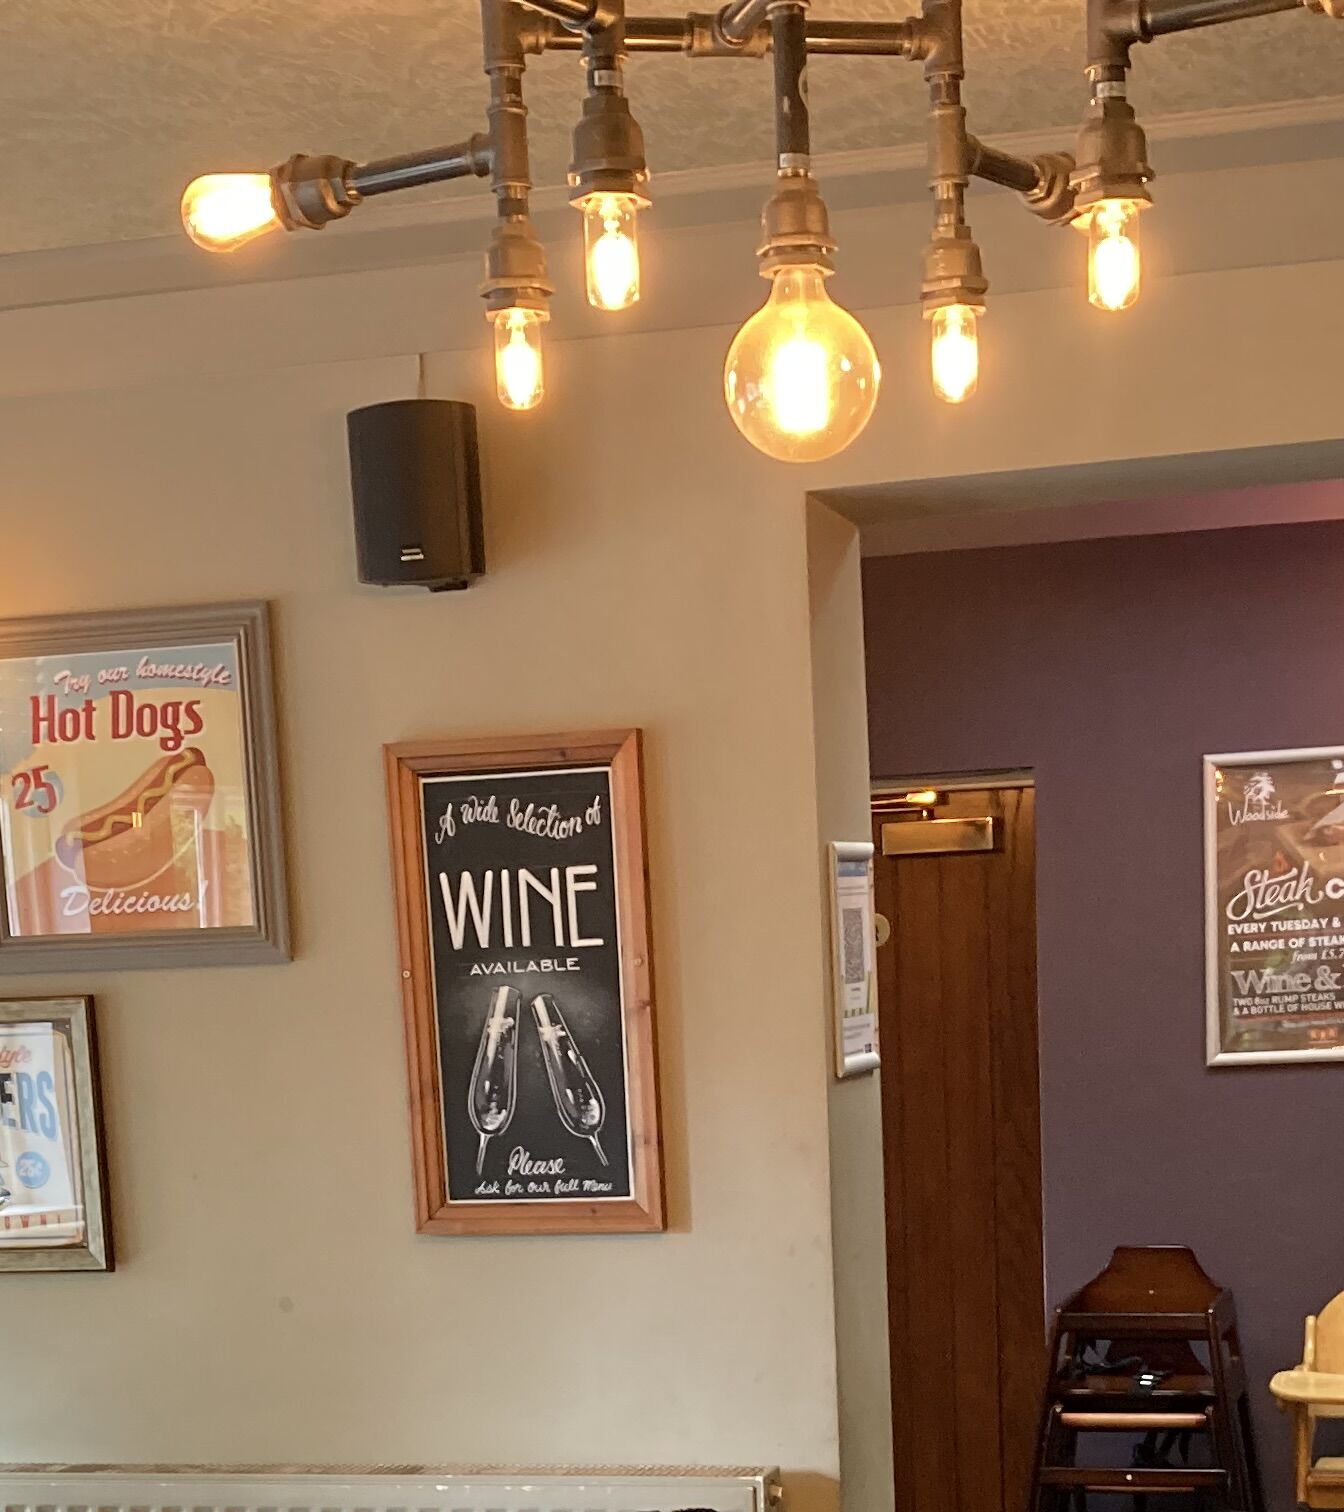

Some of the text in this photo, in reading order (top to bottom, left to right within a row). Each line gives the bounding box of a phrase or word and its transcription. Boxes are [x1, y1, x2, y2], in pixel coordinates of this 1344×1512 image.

[54, 656, 232, 695] Try our homestyle
[30, 689, 204, 752] Hot Dogs
[11, 764, 58, 814] 25
[506, 798, 583, 840] Selection
[585, 795, 601, 825] of
[1227, 801, 1290, 826] Woodside
[1225, 860, 1324, 921] Steak
[438, 864, 605, 950] WINE
[1227, 922, 1267, 936] EVERY
[1270, 916, 1329, 933] TUESDAY
[1331, 916, 1341, 928] &
[1230, 941, 1241, 953] A
[1243, 938, 1285, 952] RANGE
[1288, 936, 1306, 949] OF
[470, 957, 581, 976] AVAILABLE
[1230, 966, 1312, 996] Wine
[1313, 964, 1342, 992] &
[1233, 997, 1252, 1007] TWO
[1271, 994, 1299, 1004] RUMP
[1300, 991, 1336, 1002] STEAKS
[1250, 1004, 1285, 1015] BOTTLE
[1286, 1003, 1298, 1013] OF
[1300, 1001, 1333, 1012] HOUSE
[507, 1146, 566, 1176] Please
[504, 1179, 525, 1195] for
[527, 1182, 551, 1193] our
[554, 1178, 579, 1195] full
